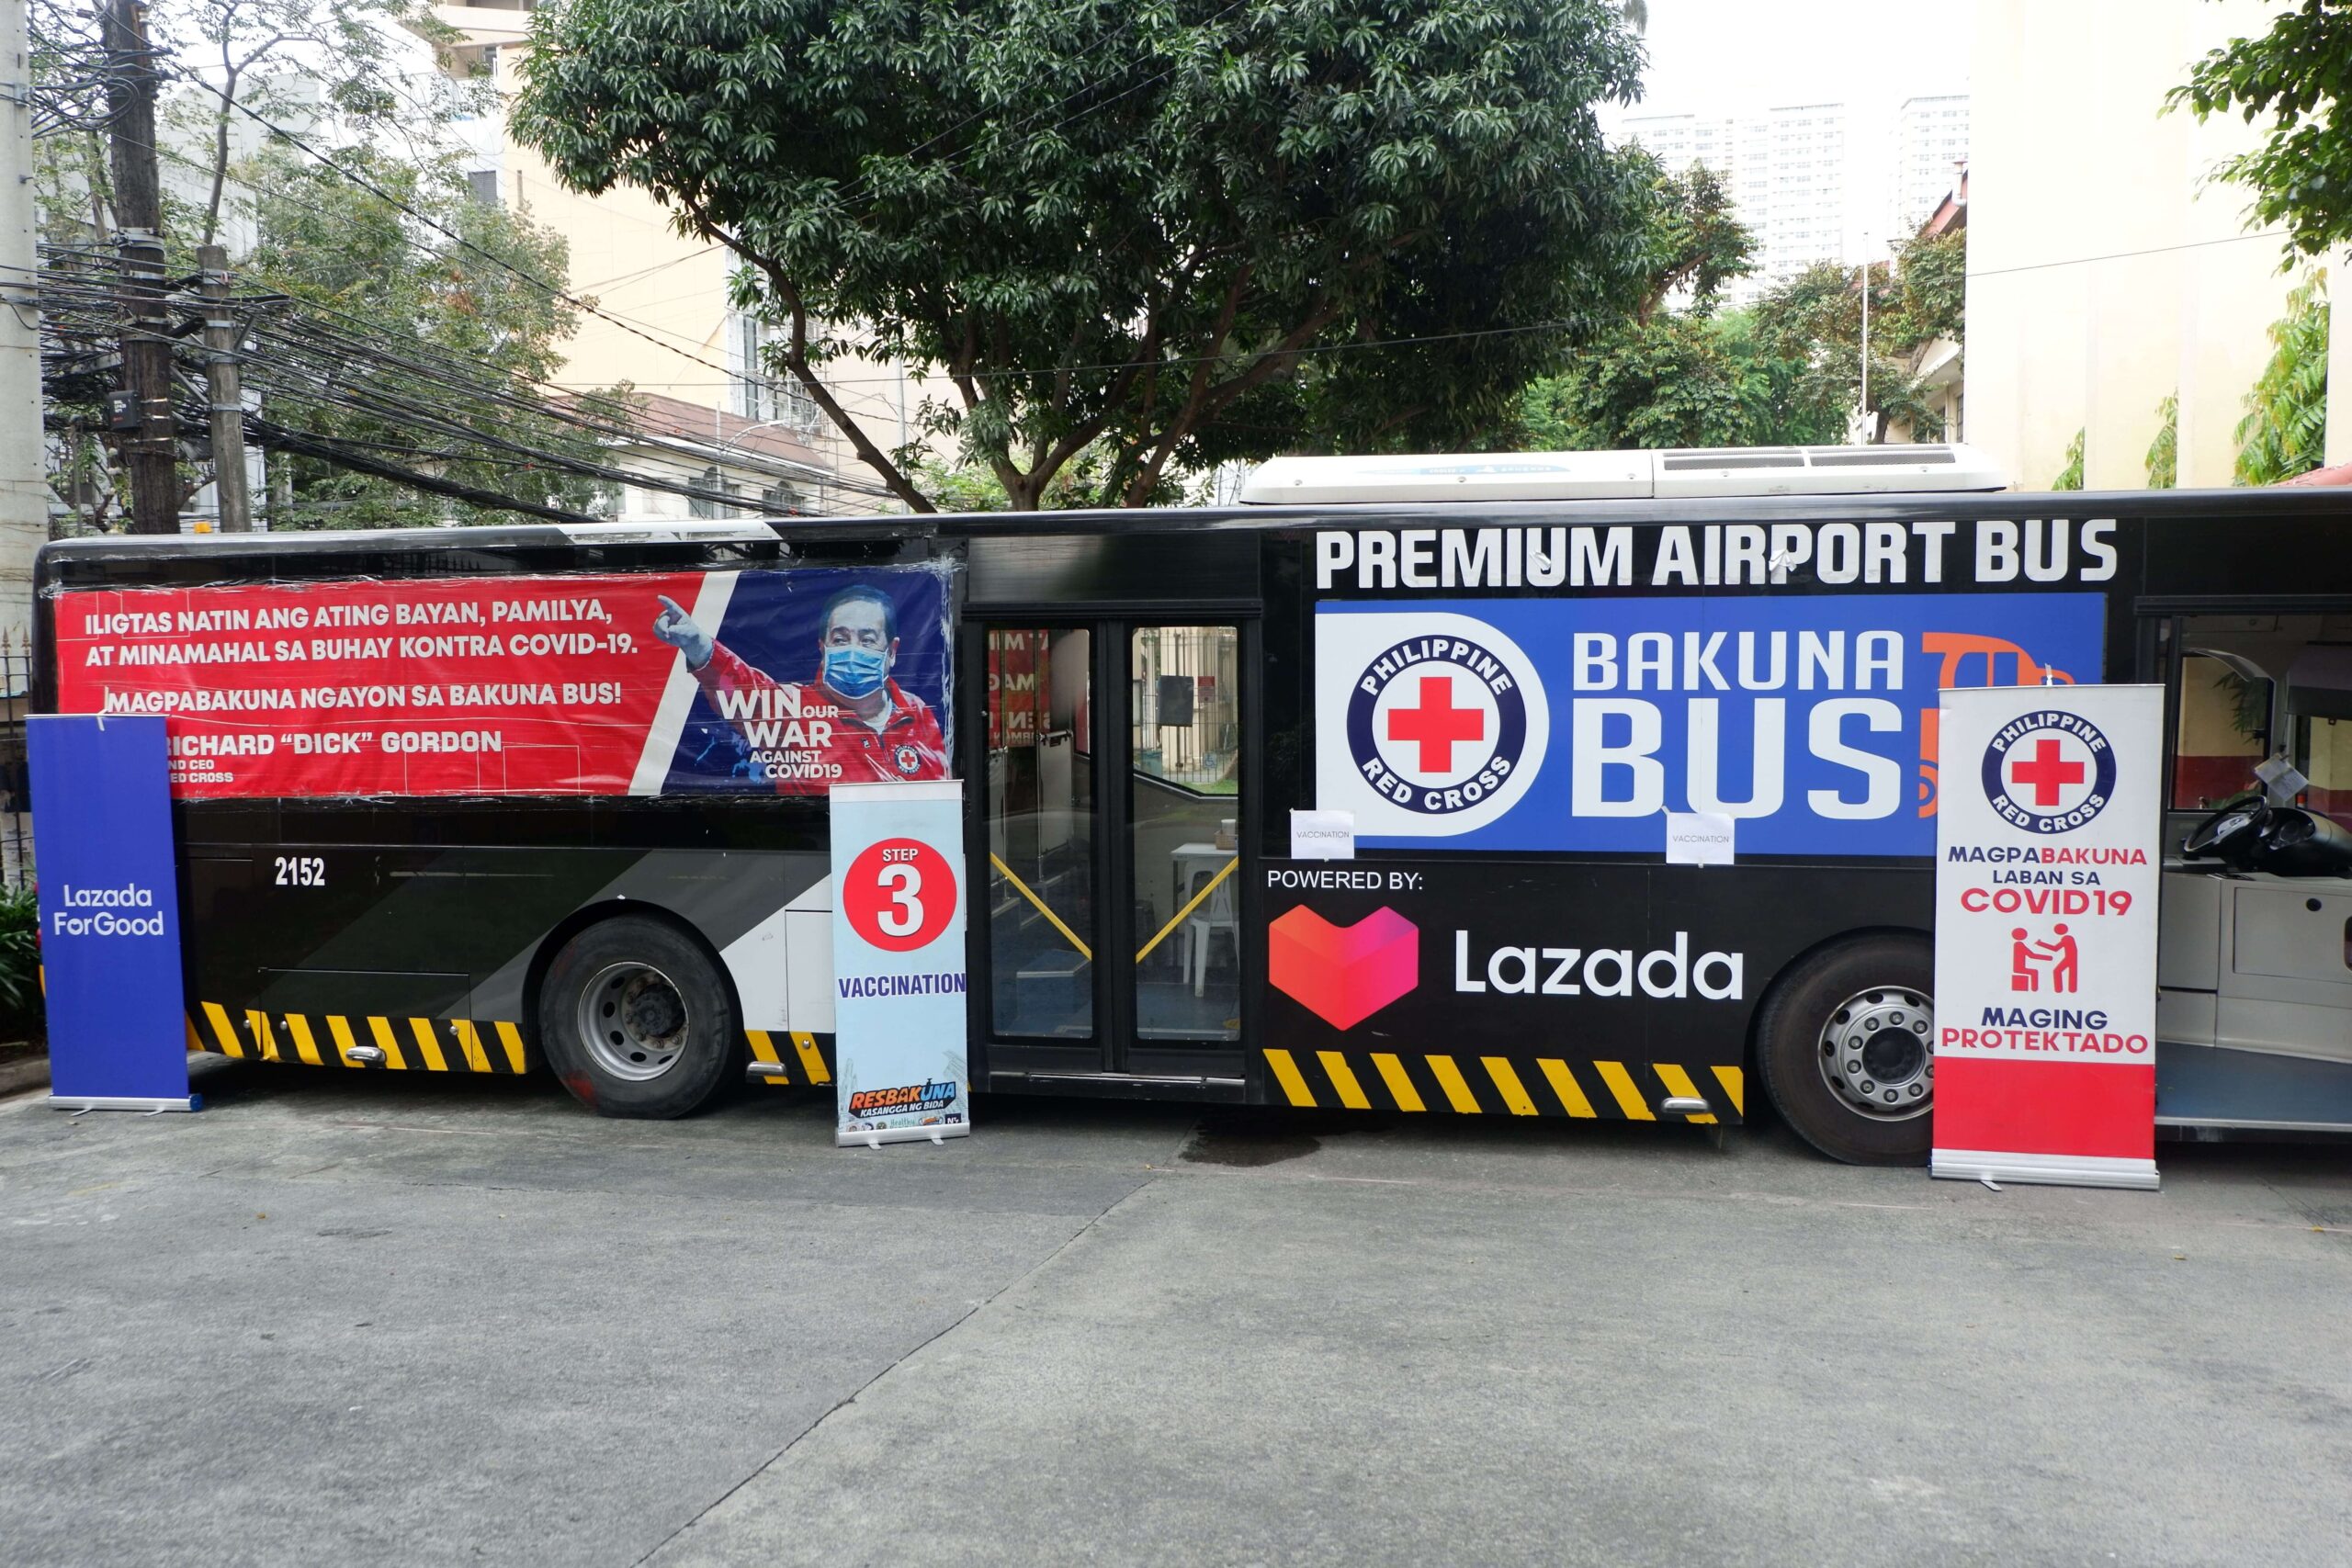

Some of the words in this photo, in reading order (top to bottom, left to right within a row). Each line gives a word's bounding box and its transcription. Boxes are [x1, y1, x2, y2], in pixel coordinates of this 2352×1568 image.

[1316, 525, 1633, 589] PREMIUM
[1651, 522, 1956, 586] AIRPORT
[1974, 518, 2118, 582] BUS
[85, 611, 173, 634] ILIGTAS
[177, 608, 250, 632] NATIN
[254, 605, 310, 629] ANG
[314, 603, 390, 627] ATING
[396, 601, 486, 627] BAYAN,
[492, 598, 613, 625] PAMILYA,
[85, 646, 114, 667] AT
[119, 641, 271, 666] MINAMAHAL
[275, 639, 306, 661] SA
[311, 637, 393, 660] BUHAY
[400, 634, 505, 658] KONTRA
[509, 632, 639, 656] COVID-19.
[1573, 630, 1905, 691] BAKUNA
[1360, 638, 1514, 696] PHILIPPINE
[108, 688, 297, 713] MAGPABAKUNA
[301, 685, 405, 708] NGAYON
[412, 685, 447, 706] SA
[449, 683, 557, 706] BAKUNA
[563, 682, 622, 705] BUS!
[716, 687, 801, 720] WIN
[802, 705, 839, 718] OUR
[381, 731, 502, 753] GORDON
[742, 720, 833, 748] WAR
[1992, 713, 2106, 753] PHILIPPINE
[188, 759, 215, 771] CEO
[750, 750, 822, 763] AGAINST
[1572, 697, 1904, 819] BUS
[170, 773, 187, 783] ED
[188, 772, 234, 784] CROSS
[764, 763, 842, 779] COVID19
[1361, 757, 1414, 810] RED
[1424, 755, 1511, 811] CROSS
[1992, 794, 2030, 828] RED
[2038, 793, 2105, 832] CROSS
[1296, 830, 1350, 839] VACCINATION
[1672, 835, 1729, 843] VACCINATION
[882, 848, 919, 863] STEP
[1948, 846, 2147, 865] MAGPABAKUNA
[275, 856, 325, 886] 2152
[1267, 870, 1382, 889] POWERED
[1389, 872, 1423, 890] BY:
[1993, 870, 2063, 885] LABAN
[2071, 871, 2101, 886] SA
[63, 883, 153, 908] Lazada
[877, 863, 924, 937] 3
[1961, 887, 2132, 916] COVID19
[1455, 930, 1745, 1000] Lazada
[838, 972, 967, 998] VACCINATION
[1981, 1007, 2109, 1030] MAGING
[1941, 1027, 2149, 1055] PROTEKTADO
[851, 1080, 956, 1110] RESBAKUNA
[860, 1104, 908, 1118] KASANGGA
[909, 1102, 922, 1112] NG
[923, 1100, 944, 1111] BIDA
